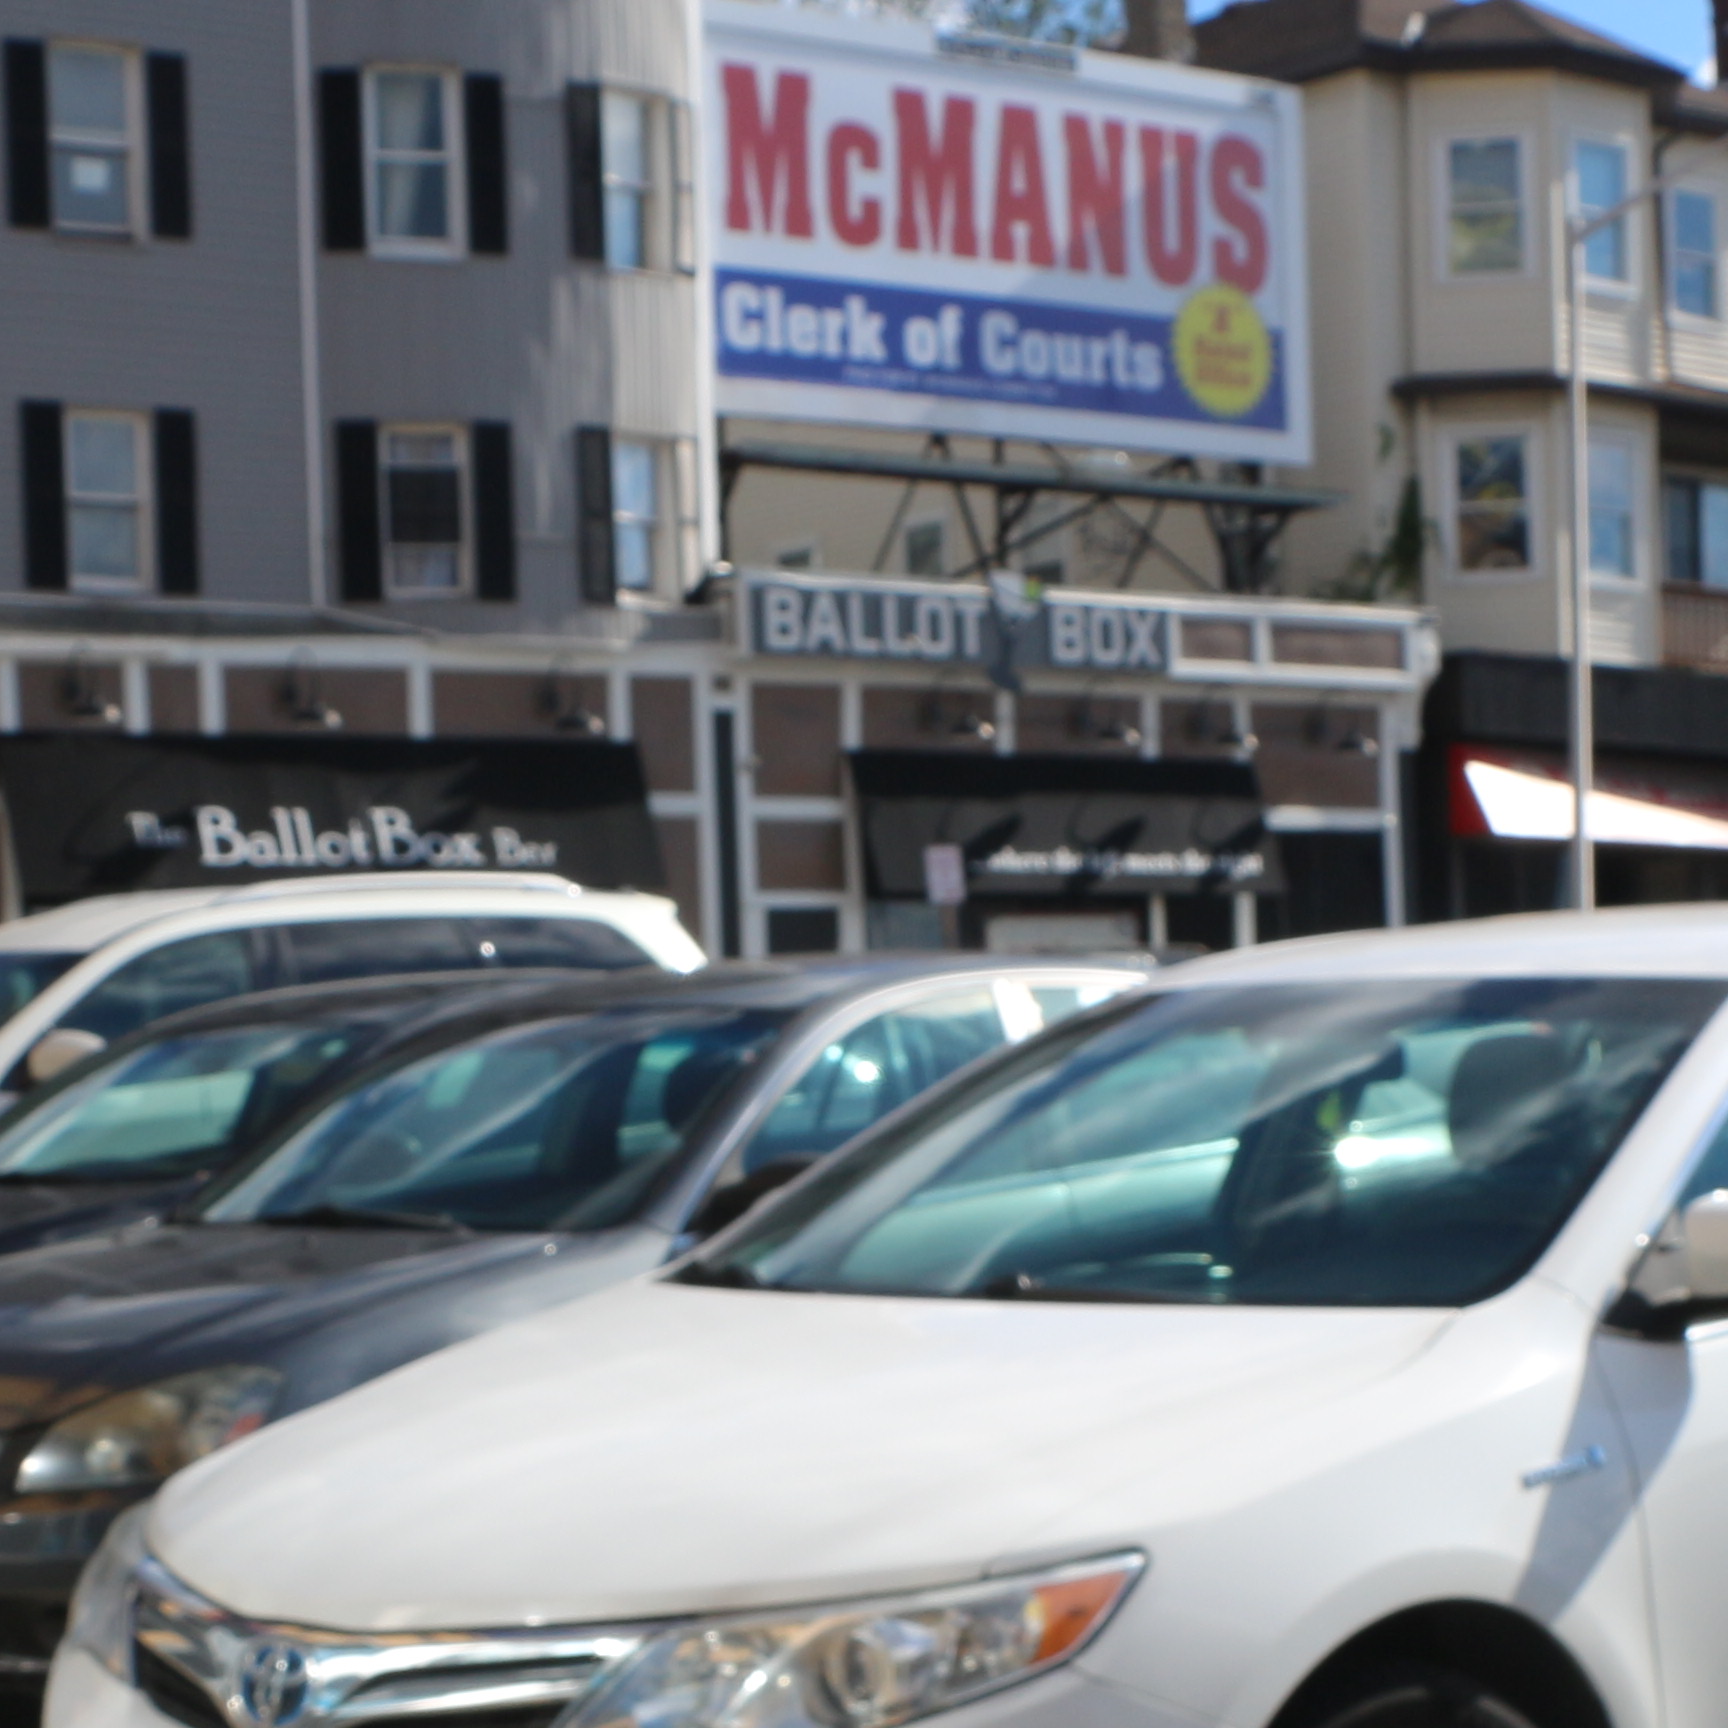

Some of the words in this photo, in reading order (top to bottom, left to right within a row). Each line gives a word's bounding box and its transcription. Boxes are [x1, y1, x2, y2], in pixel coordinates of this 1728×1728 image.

[721, 62, 1268, 295] McMANUS
[720, 282, 887, 364] Clerk
[903, 305, 965, 369] of
[979, 311, 1163, 392] Courts
[763, 587, 986, 660] BALLOT
[1050, 605, 1161, 667] BOX
